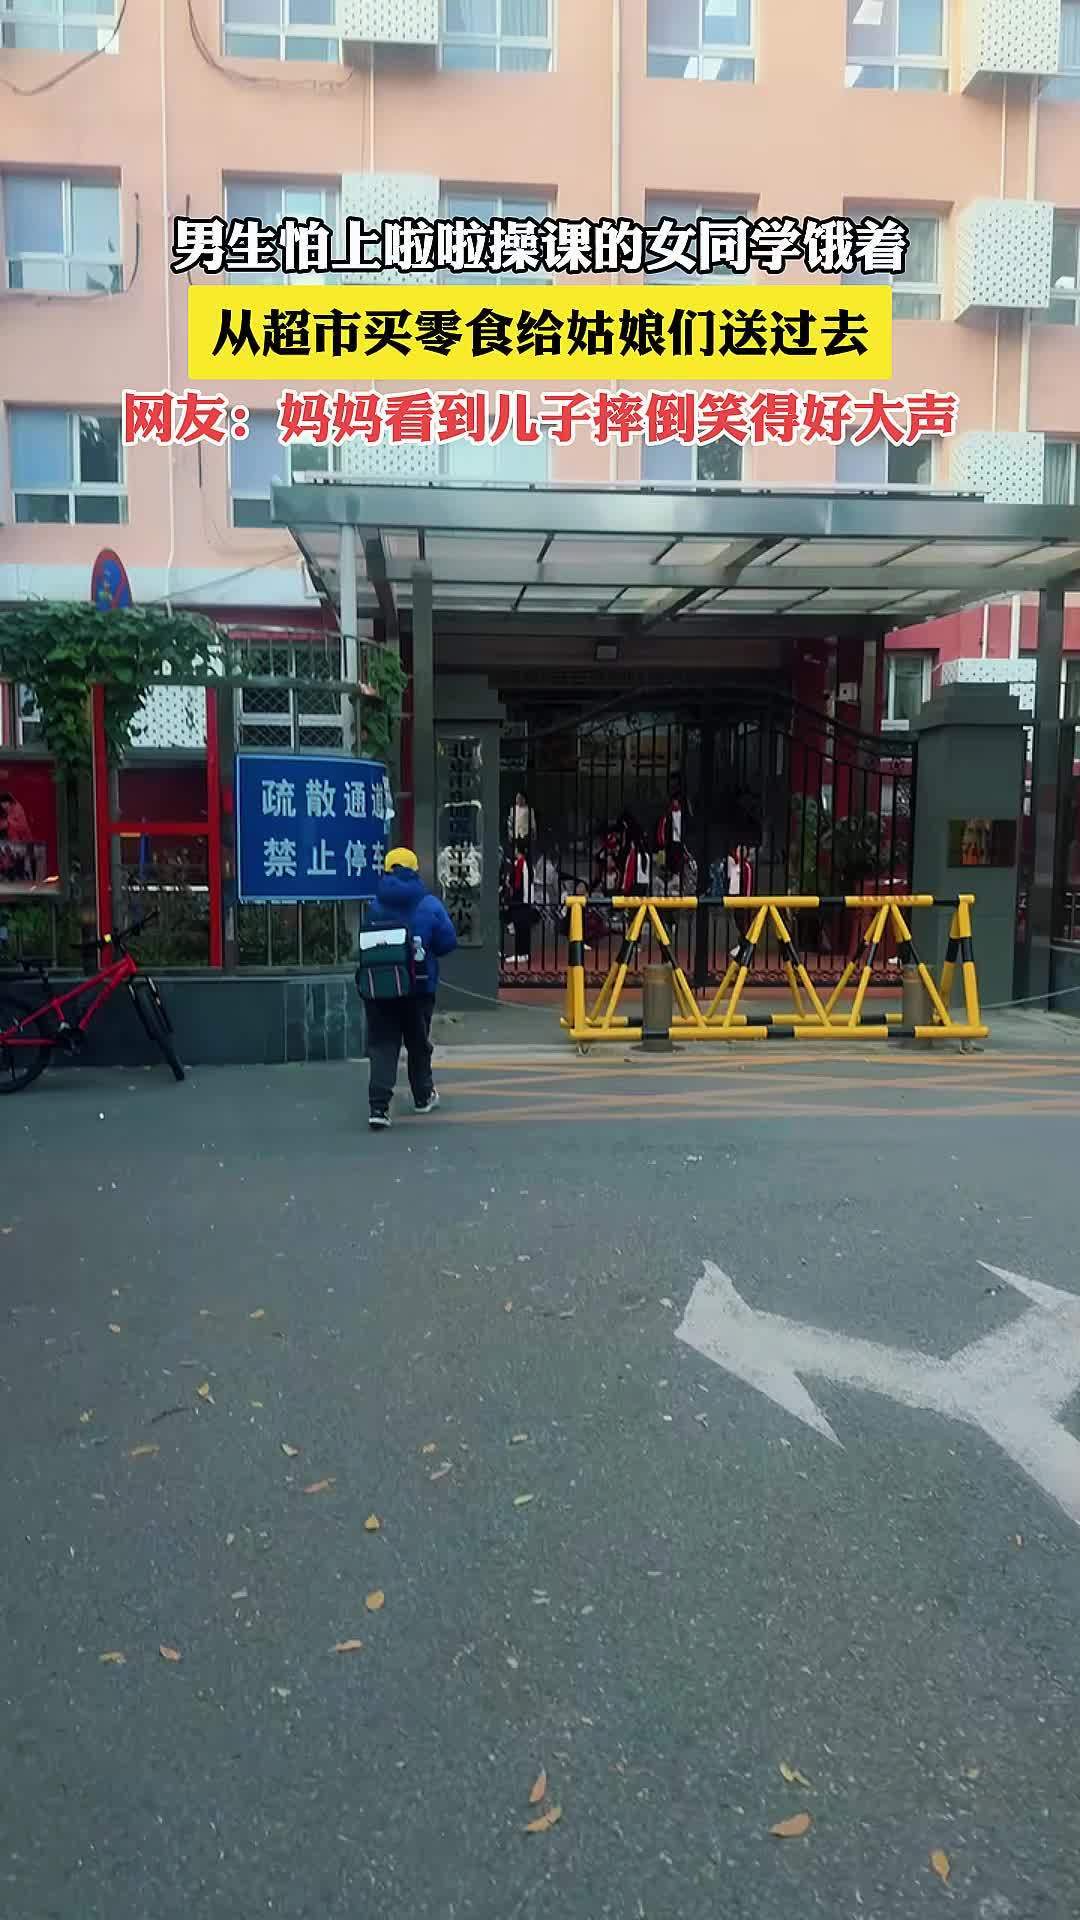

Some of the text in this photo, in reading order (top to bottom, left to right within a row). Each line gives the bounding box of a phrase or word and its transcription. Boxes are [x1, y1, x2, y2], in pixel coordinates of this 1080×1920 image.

[262, 778, 386, 819] 疏散通道
[263, 837, 385, 877] 禁止停车
